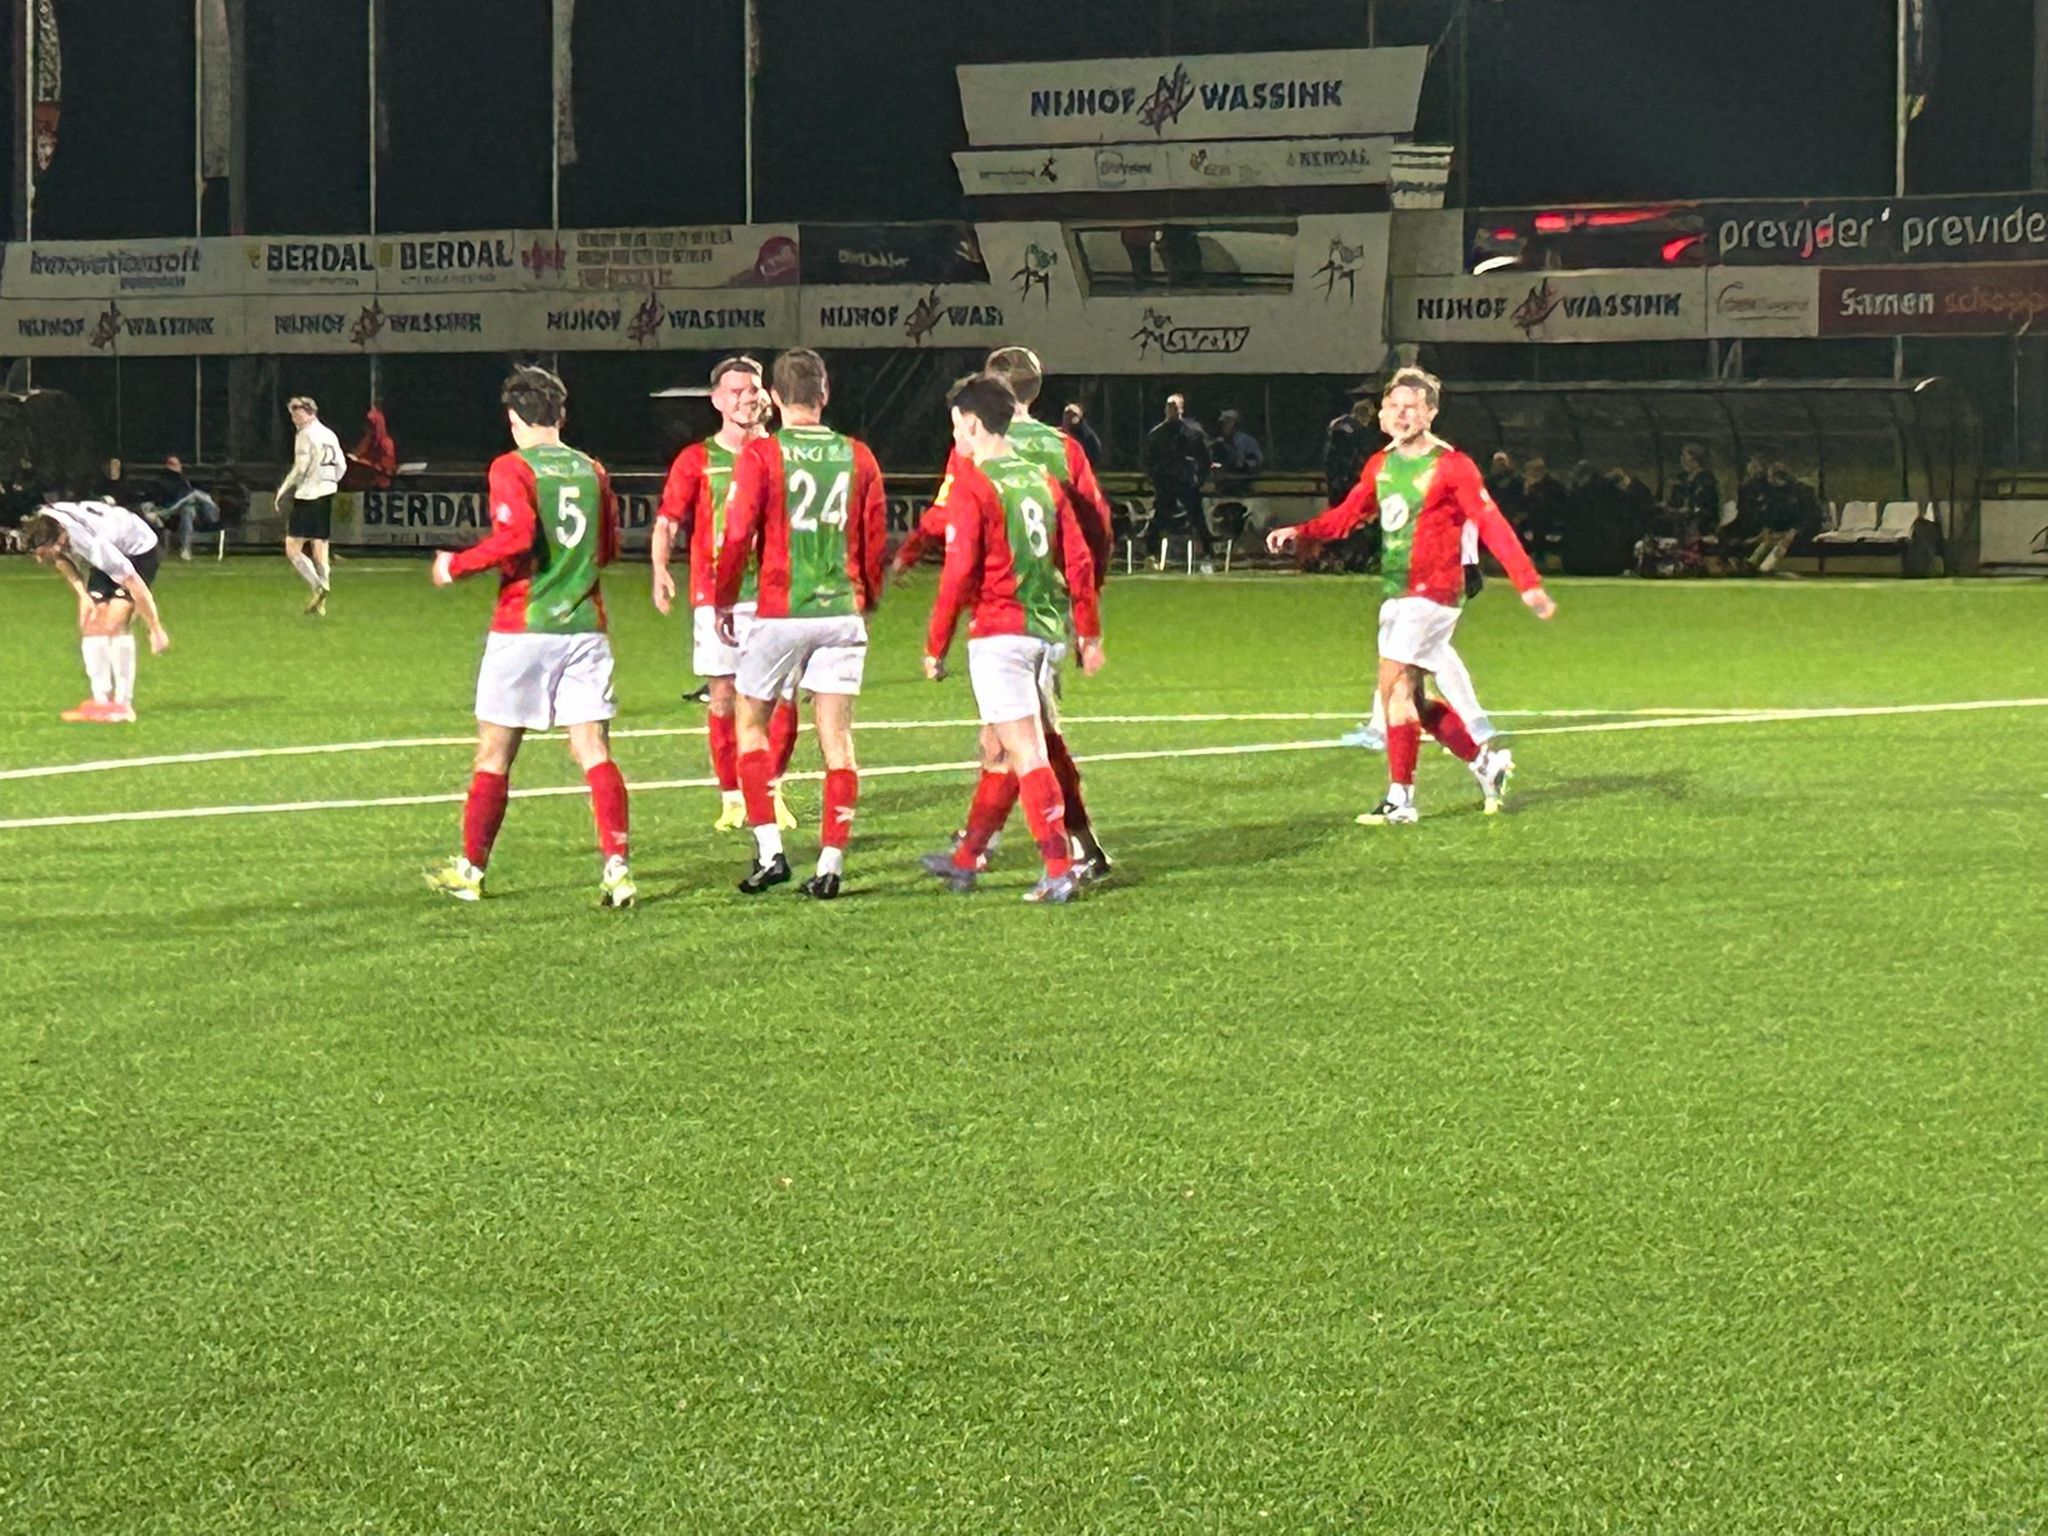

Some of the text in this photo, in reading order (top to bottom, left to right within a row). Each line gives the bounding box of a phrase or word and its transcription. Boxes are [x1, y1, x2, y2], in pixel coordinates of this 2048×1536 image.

[1031, 79, 1344, 117] NIJHOF WASSINK
[267, 243, 375, 272] BERDAL
[400, 238, 512, 270] BERDAL
[820, 305, 899, 328] NIJHOF
[1417, 292, 1682, 320] NIJHOF WASSINK
[1839, 287, 1935, 317] Samen
[789, 468, 849, 533] 24
[555, 486, 587, 549] 5
[1020, 497, 1049, 557] 8
